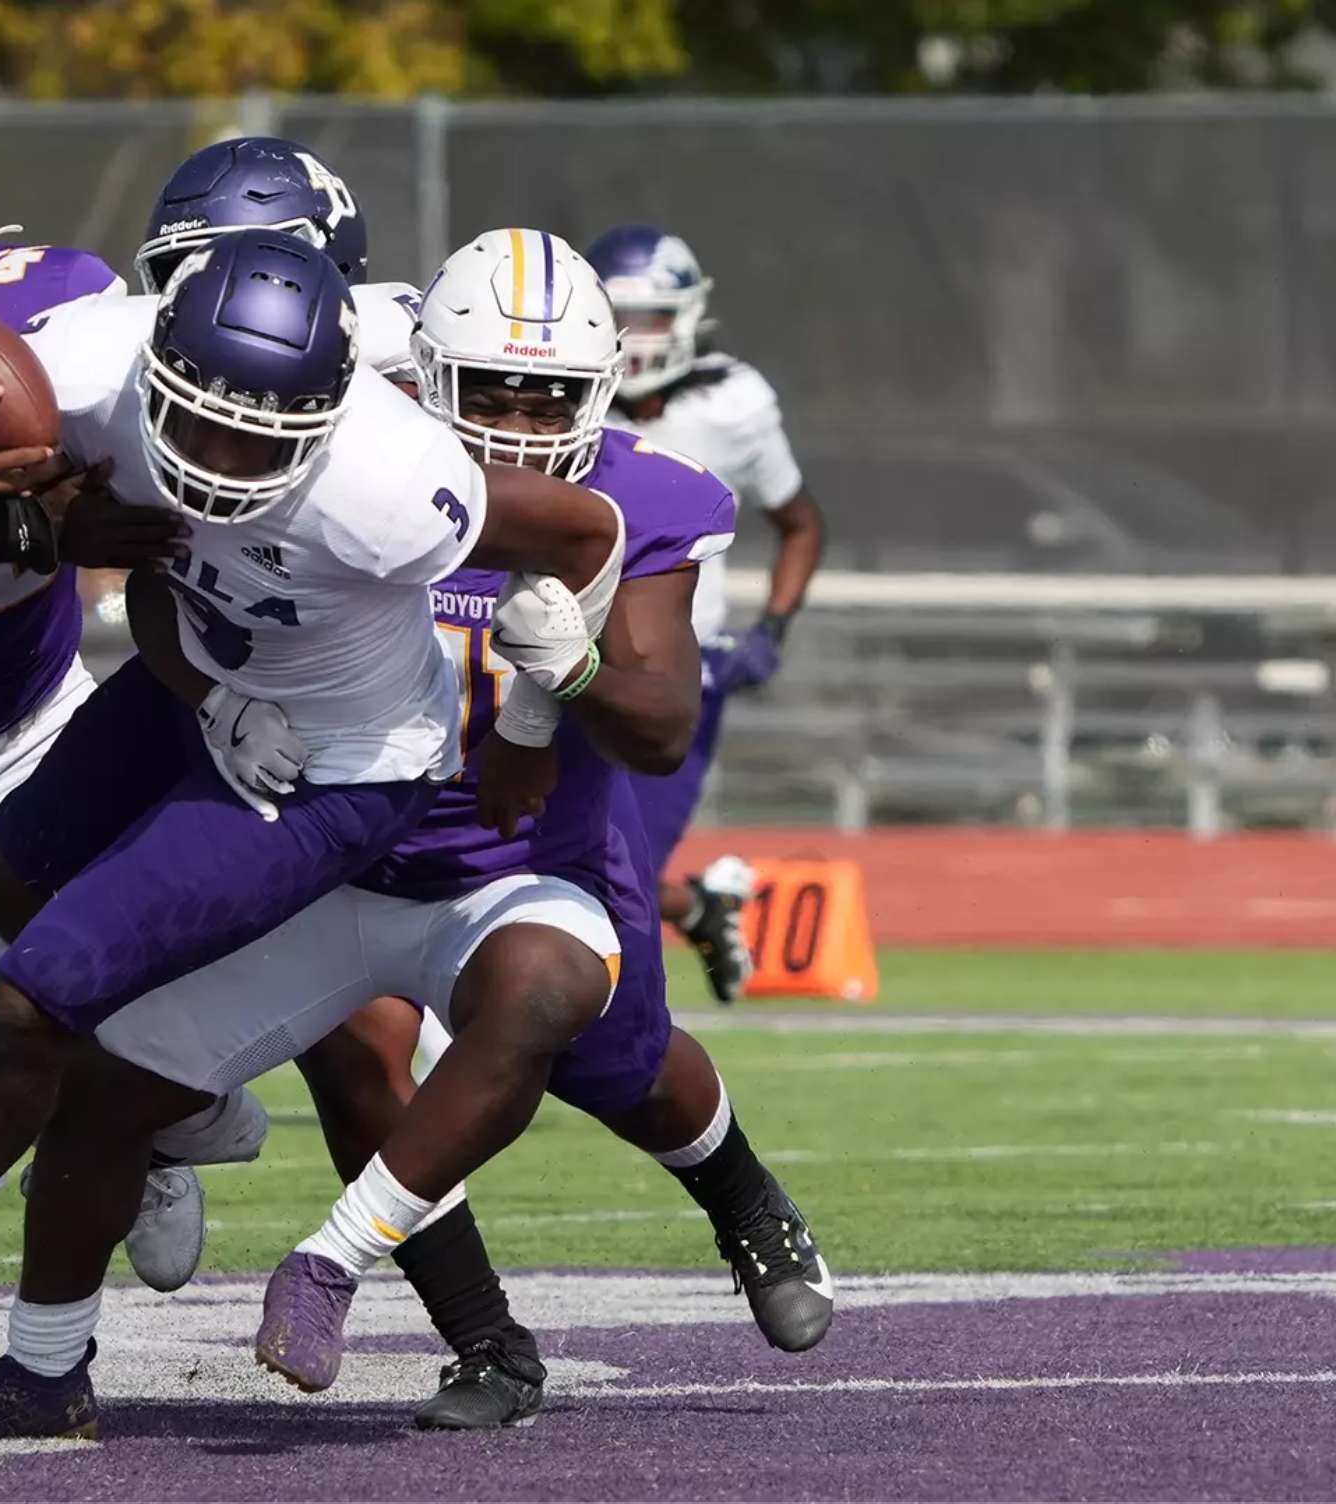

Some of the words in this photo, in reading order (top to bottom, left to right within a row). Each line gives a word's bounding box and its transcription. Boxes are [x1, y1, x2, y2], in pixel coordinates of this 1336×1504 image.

[503, 342, 556, 358] Riddell
[431, 487, 470, 543] 3
[240, 546, 292, 580] adidas
[430, 589, 497, 620] COYOT
[753, 883, 824, 972] 10
